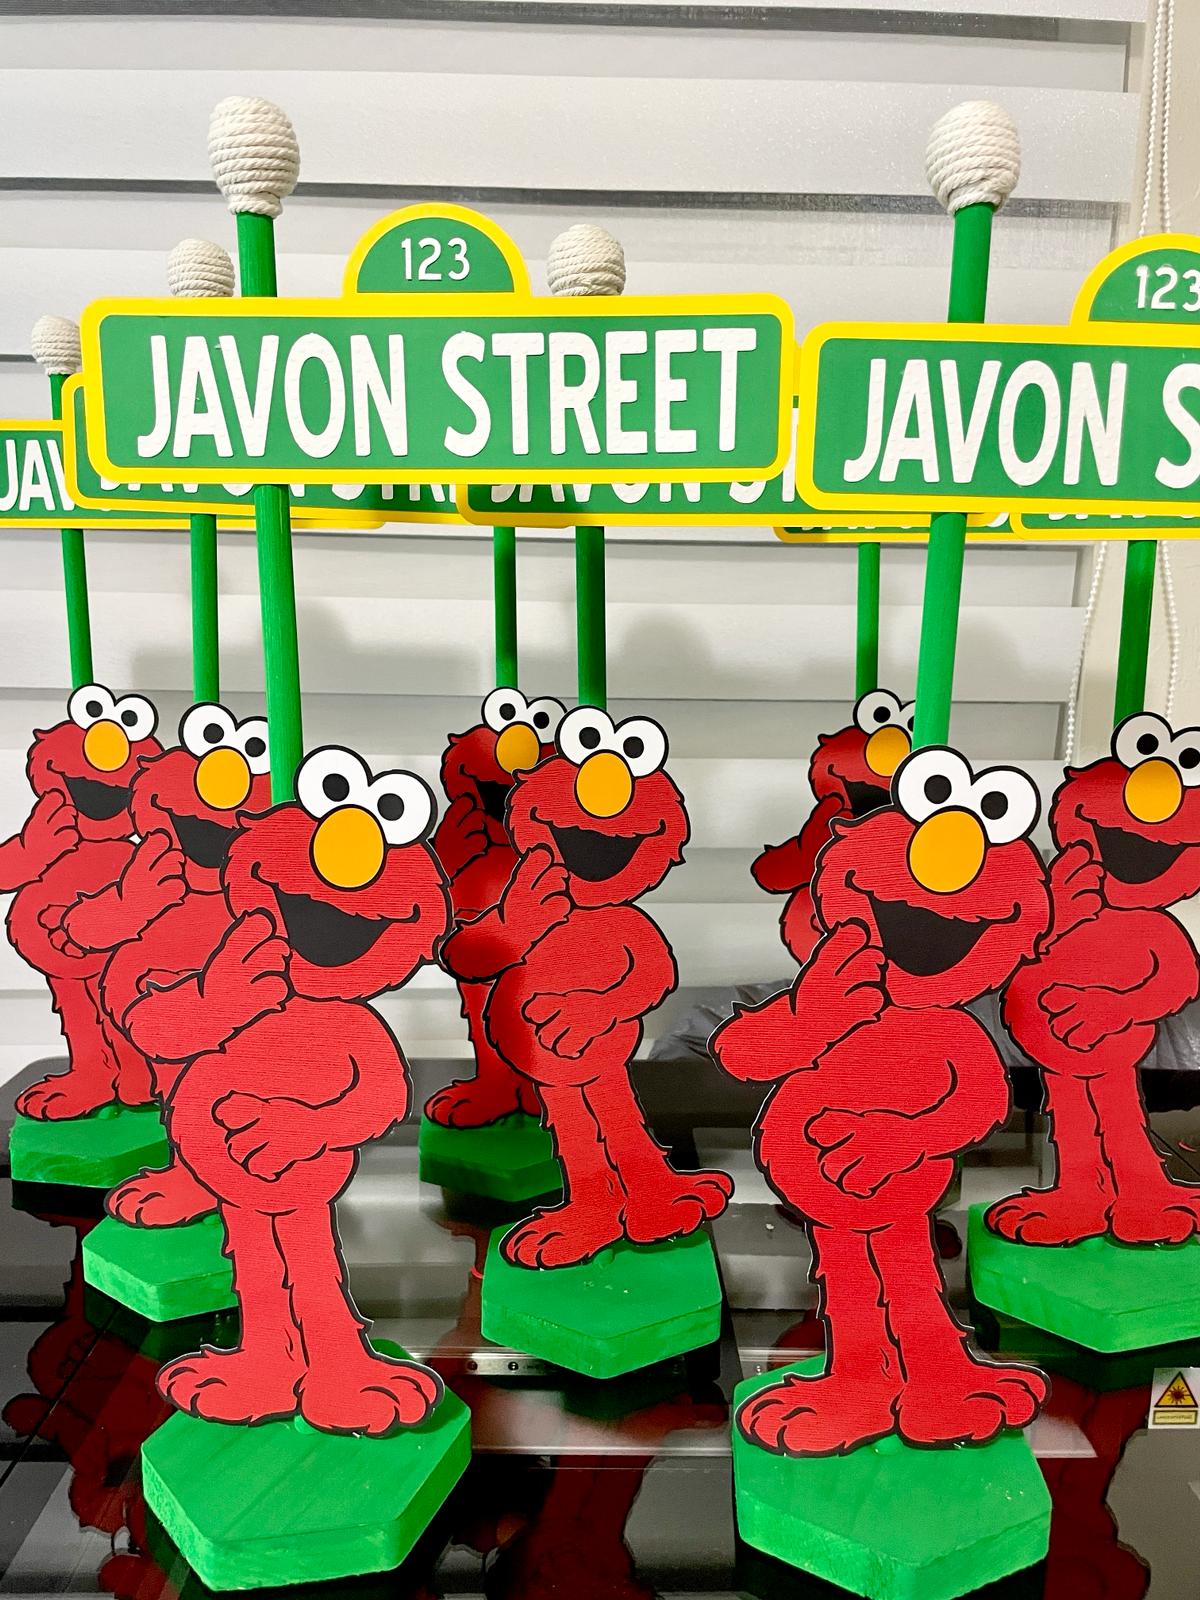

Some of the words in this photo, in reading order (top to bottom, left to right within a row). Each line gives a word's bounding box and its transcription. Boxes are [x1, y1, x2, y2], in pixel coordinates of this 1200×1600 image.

[400, 237, 471, 281] 123
[1135, 264, 1200, 312] 123
[136, 332, 408, 459] JAVON
[441, 327, 757, 457] STREET
[843, 358, 1128, 487] JAVON
[0, 439, 76, 512] JAV
